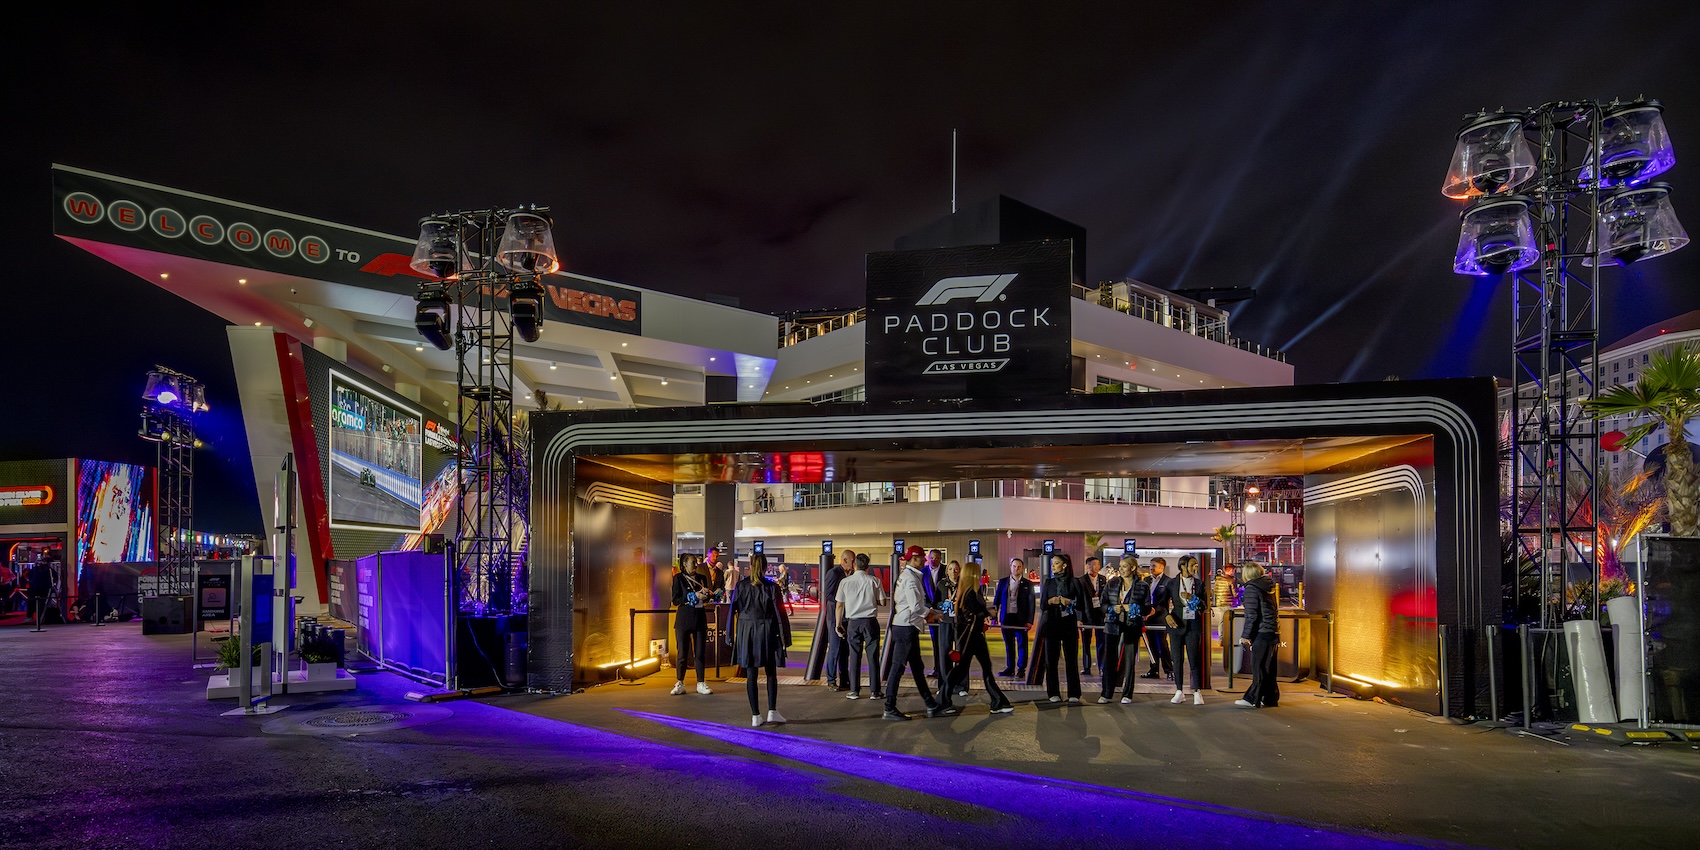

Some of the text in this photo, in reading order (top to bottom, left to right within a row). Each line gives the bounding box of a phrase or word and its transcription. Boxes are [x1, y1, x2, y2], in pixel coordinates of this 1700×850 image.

[68, 198, 321, 257] WELCOME
[335, 248, 360, 264] TO
[546, 284, 637, 321] VEGAS
[884, 307, 1051, 334] PADDOCK
[922, 333, 1011, 355] CLUB
[935, 362, 997, 371] LAS VEGAS
[332, 410, 364, 431] aramco
